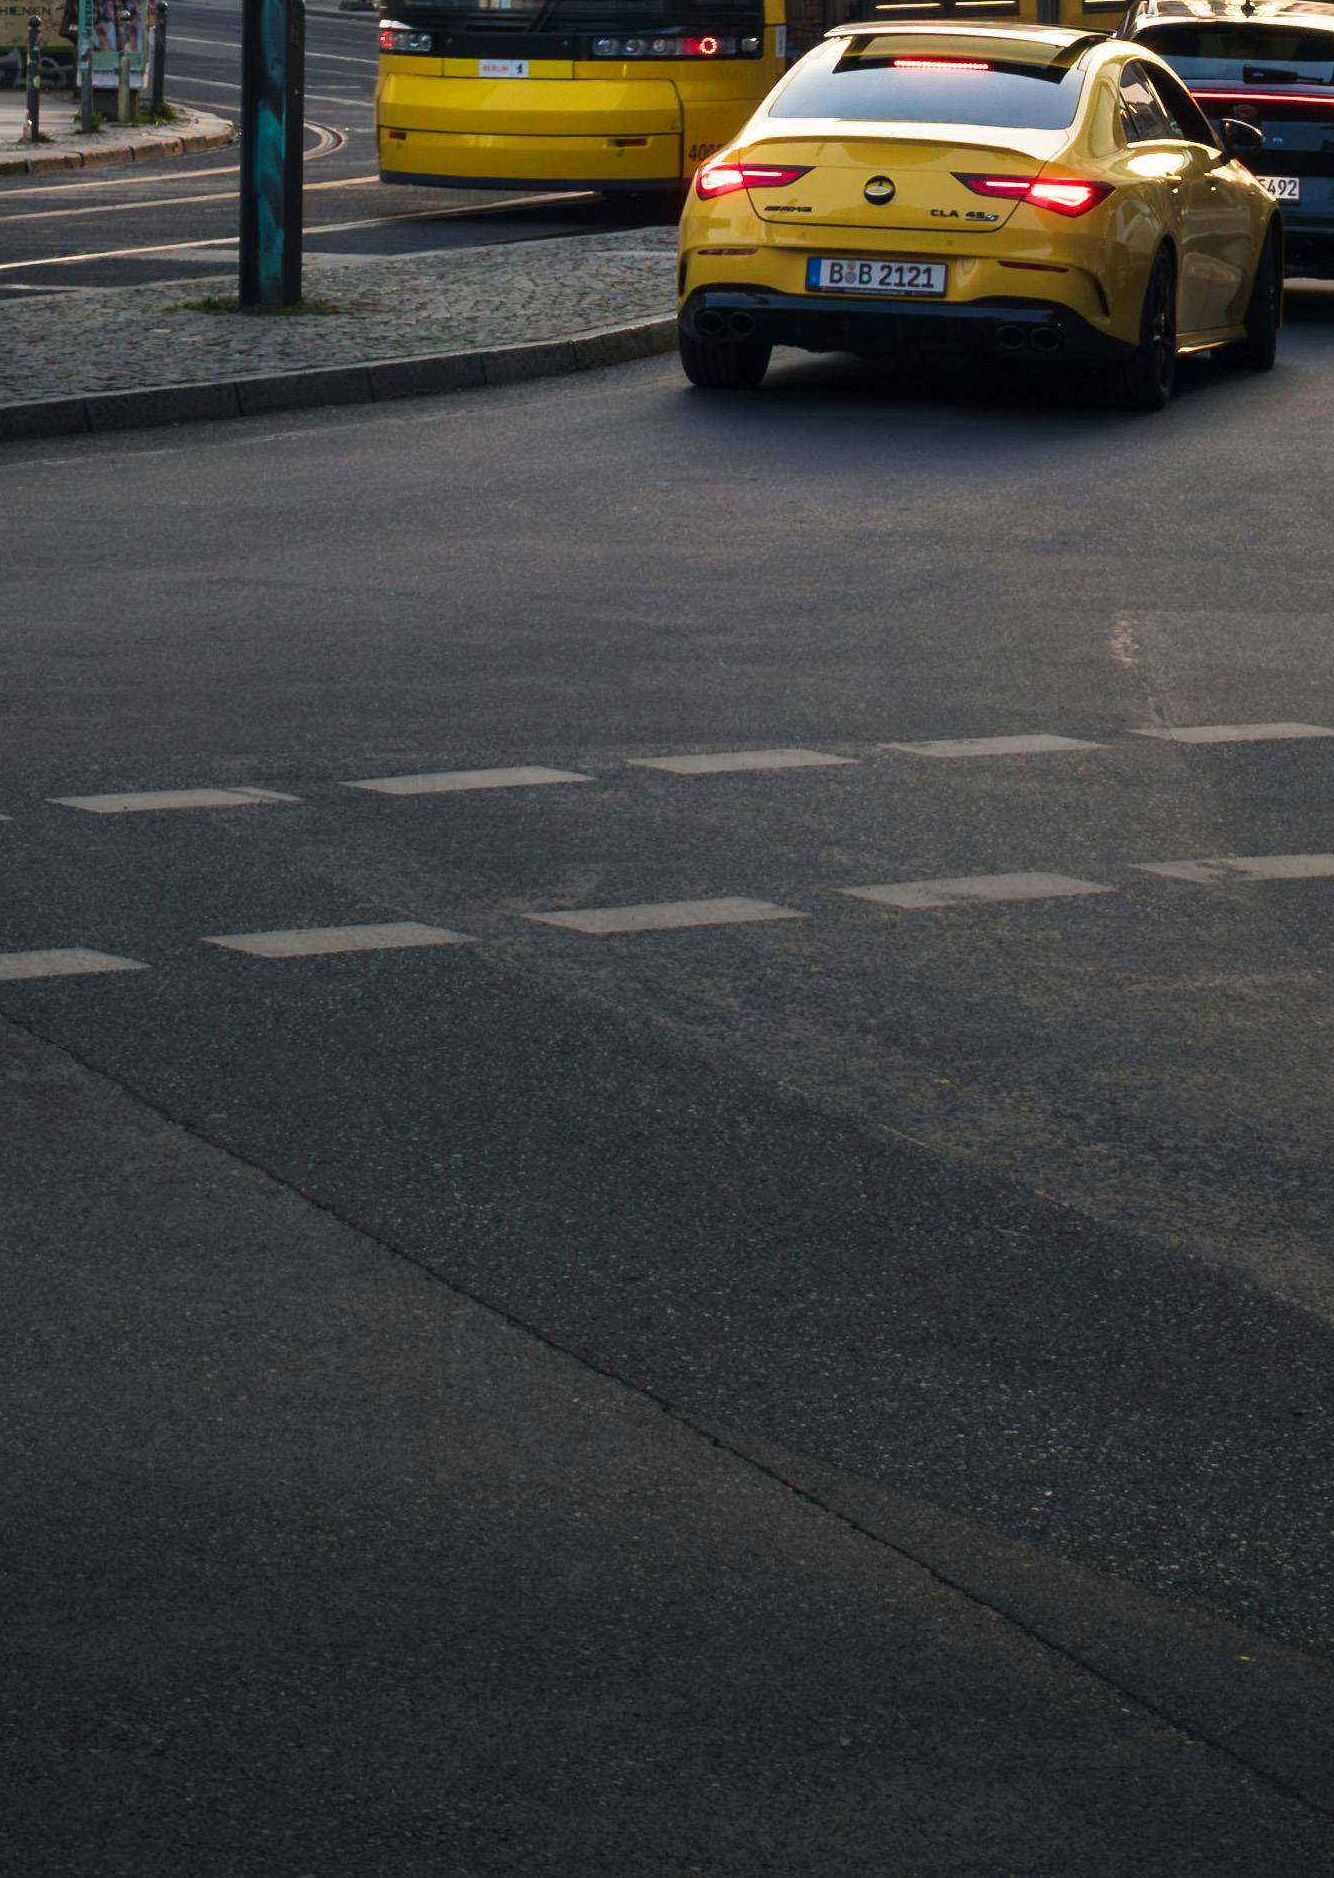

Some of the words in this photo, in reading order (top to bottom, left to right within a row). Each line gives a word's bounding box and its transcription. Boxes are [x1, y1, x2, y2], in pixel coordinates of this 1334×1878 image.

[930, 209, 959, 218] CLA
[829, 263, 843, 284] B
[858, 264, 872, 285] B
[879, 265, 934, 289] 2121
